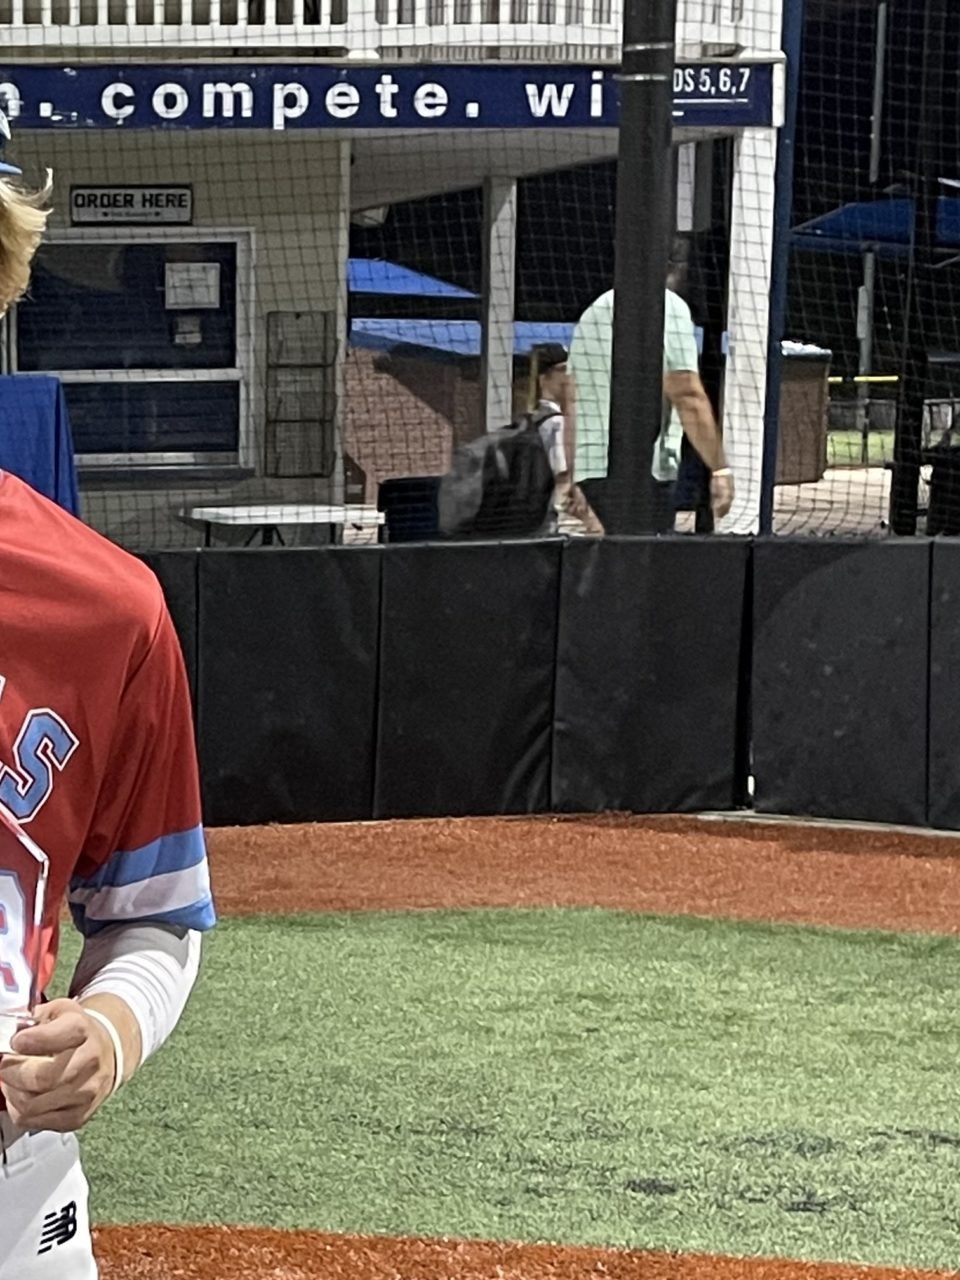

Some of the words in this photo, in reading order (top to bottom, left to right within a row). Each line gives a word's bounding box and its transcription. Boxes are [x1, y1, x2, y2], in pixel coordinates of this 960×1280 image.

[698, 67, 751, 96] 5,6,7
[101, 74, 479, 130] compete.
[73, 192, 136, 208] ORDER
[141, 192, 189, 208] HERE
